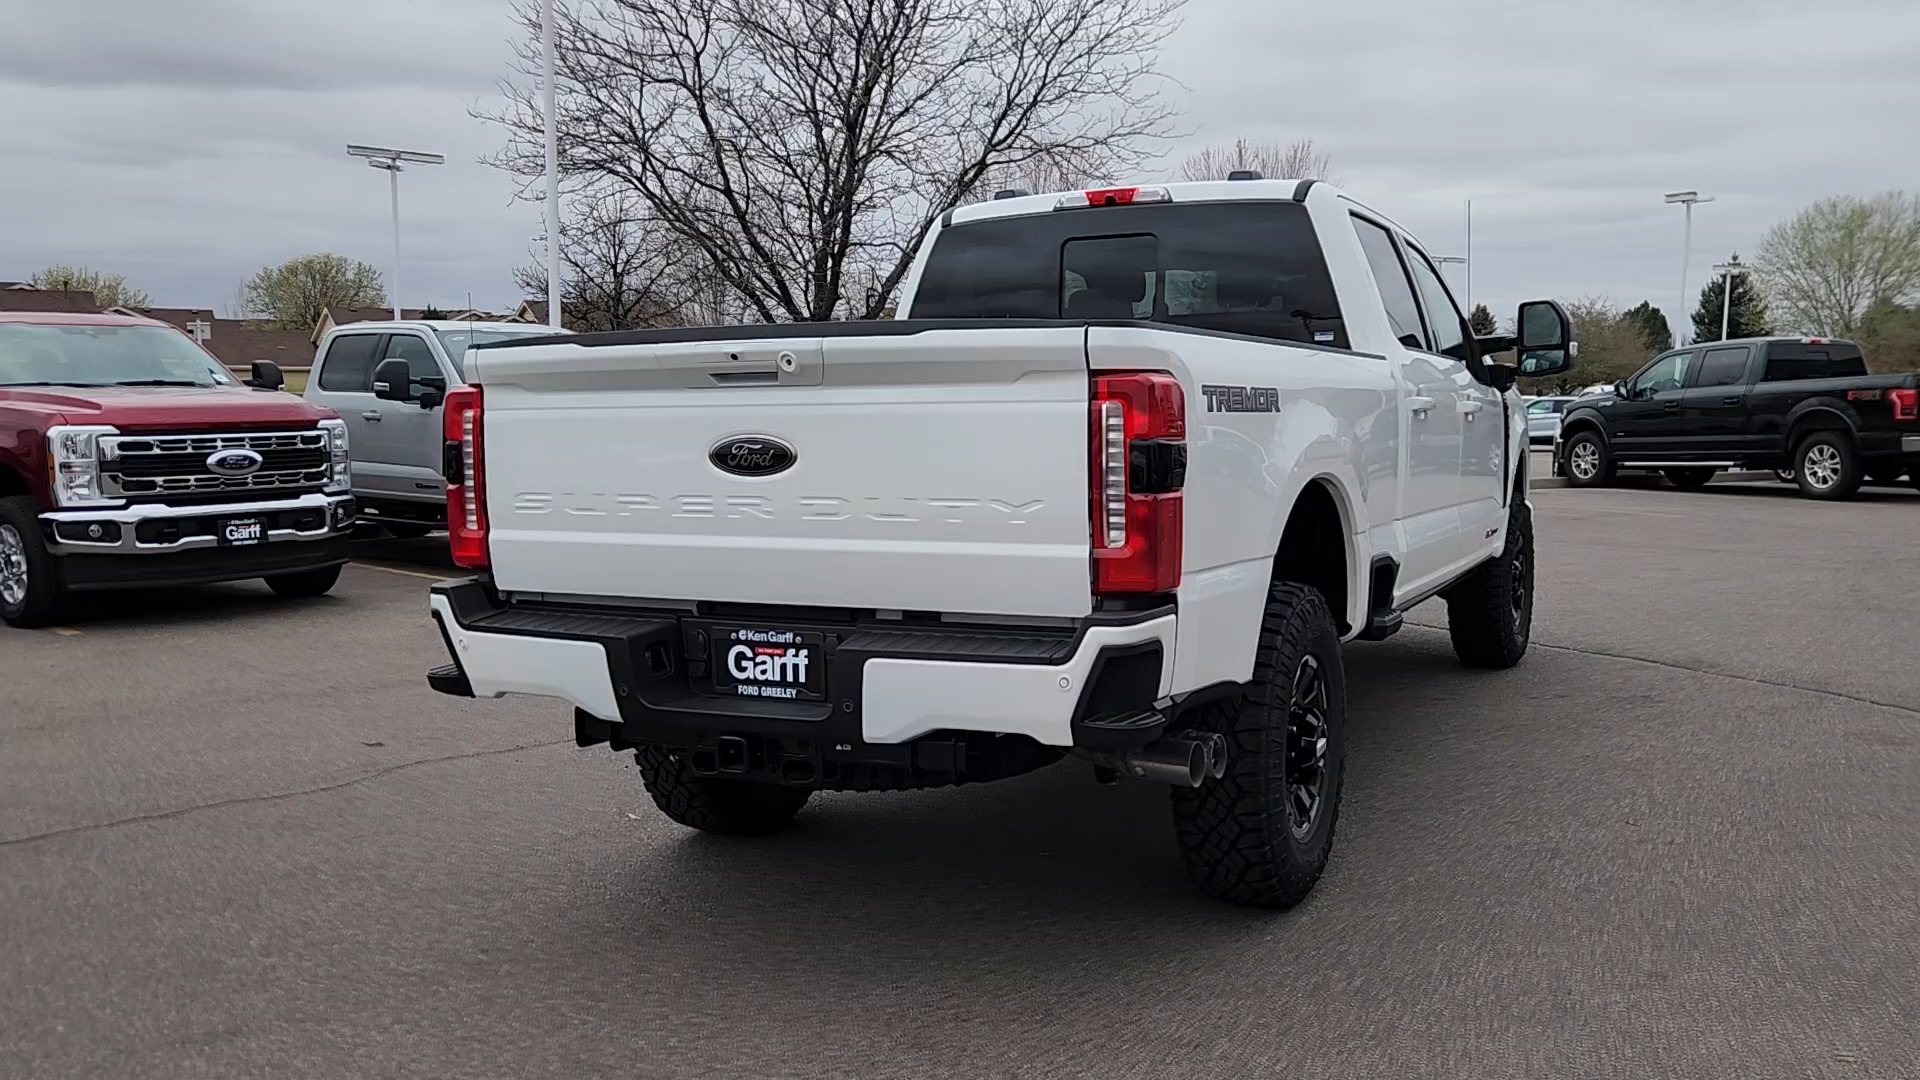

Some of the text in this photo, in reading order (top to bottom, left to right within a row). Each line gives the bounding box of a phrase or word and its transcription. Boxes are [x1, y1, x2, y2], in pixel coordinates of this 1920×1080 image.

[1201, 384, 1281, 412] TREMOR
[727, 443, 775, 466] Ford
[514, 492, 1045, 524] SUPER DUTY
[225, 524, 261, 540] Garff
[748, 630, 794, 643] Ken Garff
[727, 644, 809, 683] Garff
[738, 685, 797, 698] FORD GREELEY
